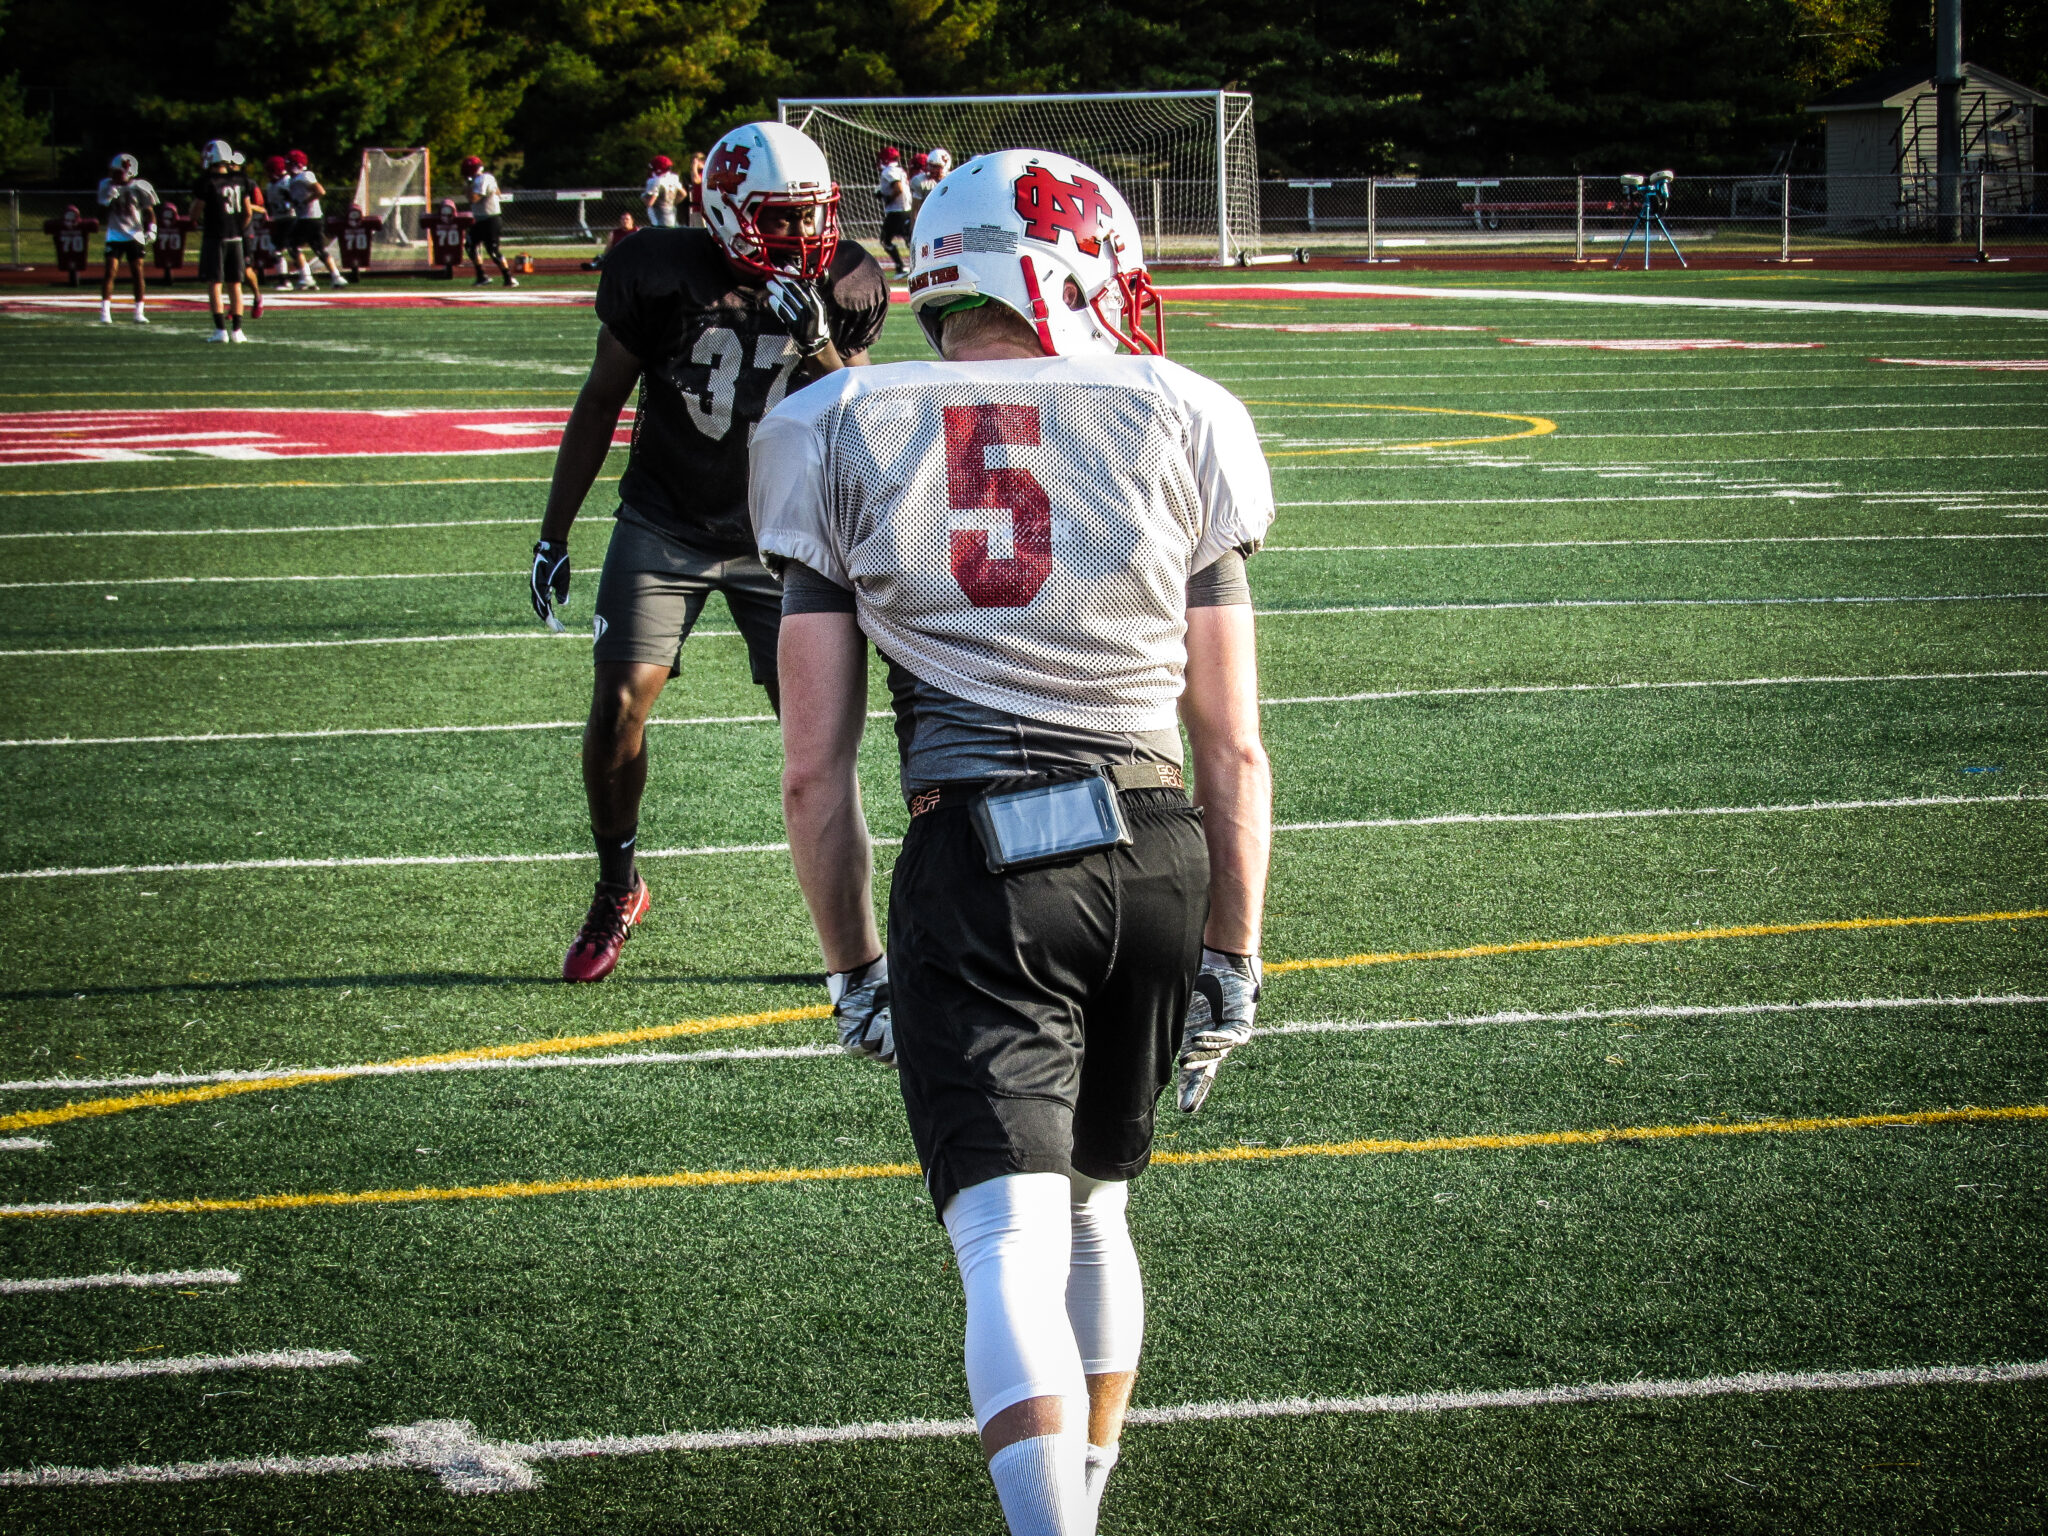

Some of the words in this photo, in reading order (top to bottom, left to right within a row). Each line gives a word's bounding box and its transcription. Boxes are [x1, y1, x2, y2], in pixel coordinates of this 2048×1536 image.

[222, 184, 242, 214] 31
[61, 235, 84, 252] 70
[344, 233, 367, 250] 70
[437, 229, 459, 246] 70
[681, 327, 802, 441] 37
[943, 403, 1052, 607] 5
